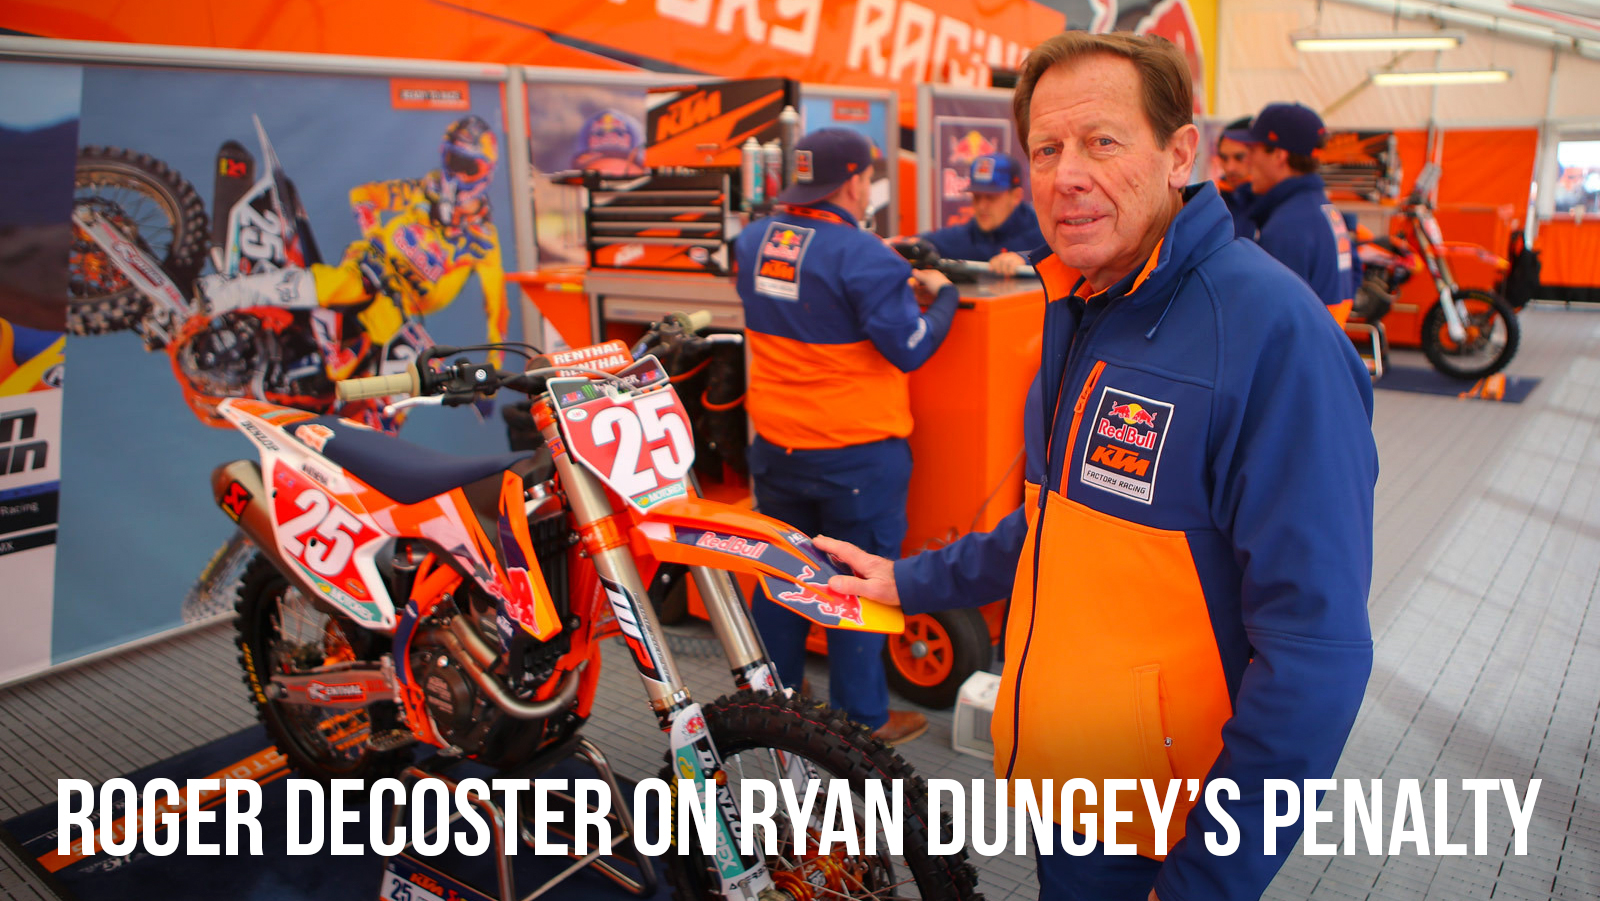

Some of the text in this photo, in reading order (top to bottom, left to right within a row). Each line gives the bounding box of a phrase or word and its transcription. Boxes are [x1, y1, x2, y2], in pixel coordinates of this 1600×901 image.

[655, 89, 722, 142] KTM
[553, 342, 623, 364] RENTHAL
[591, 391, 696, 498] 25
[1097, 417, 1157, 450] Red Bull
[1090, 443, 1151, 477] KTM
[649, 480, 685, 502] MOTOREX
[1087, 469, 1118, 486] FACTORY
[277, 488, 364, 577] 25
[696, 531, 732, 553] Red
[728, 535, 769, 559] Bull
[390, 877, 413, 901] 25
[409, 872, 445, 898] KTM
